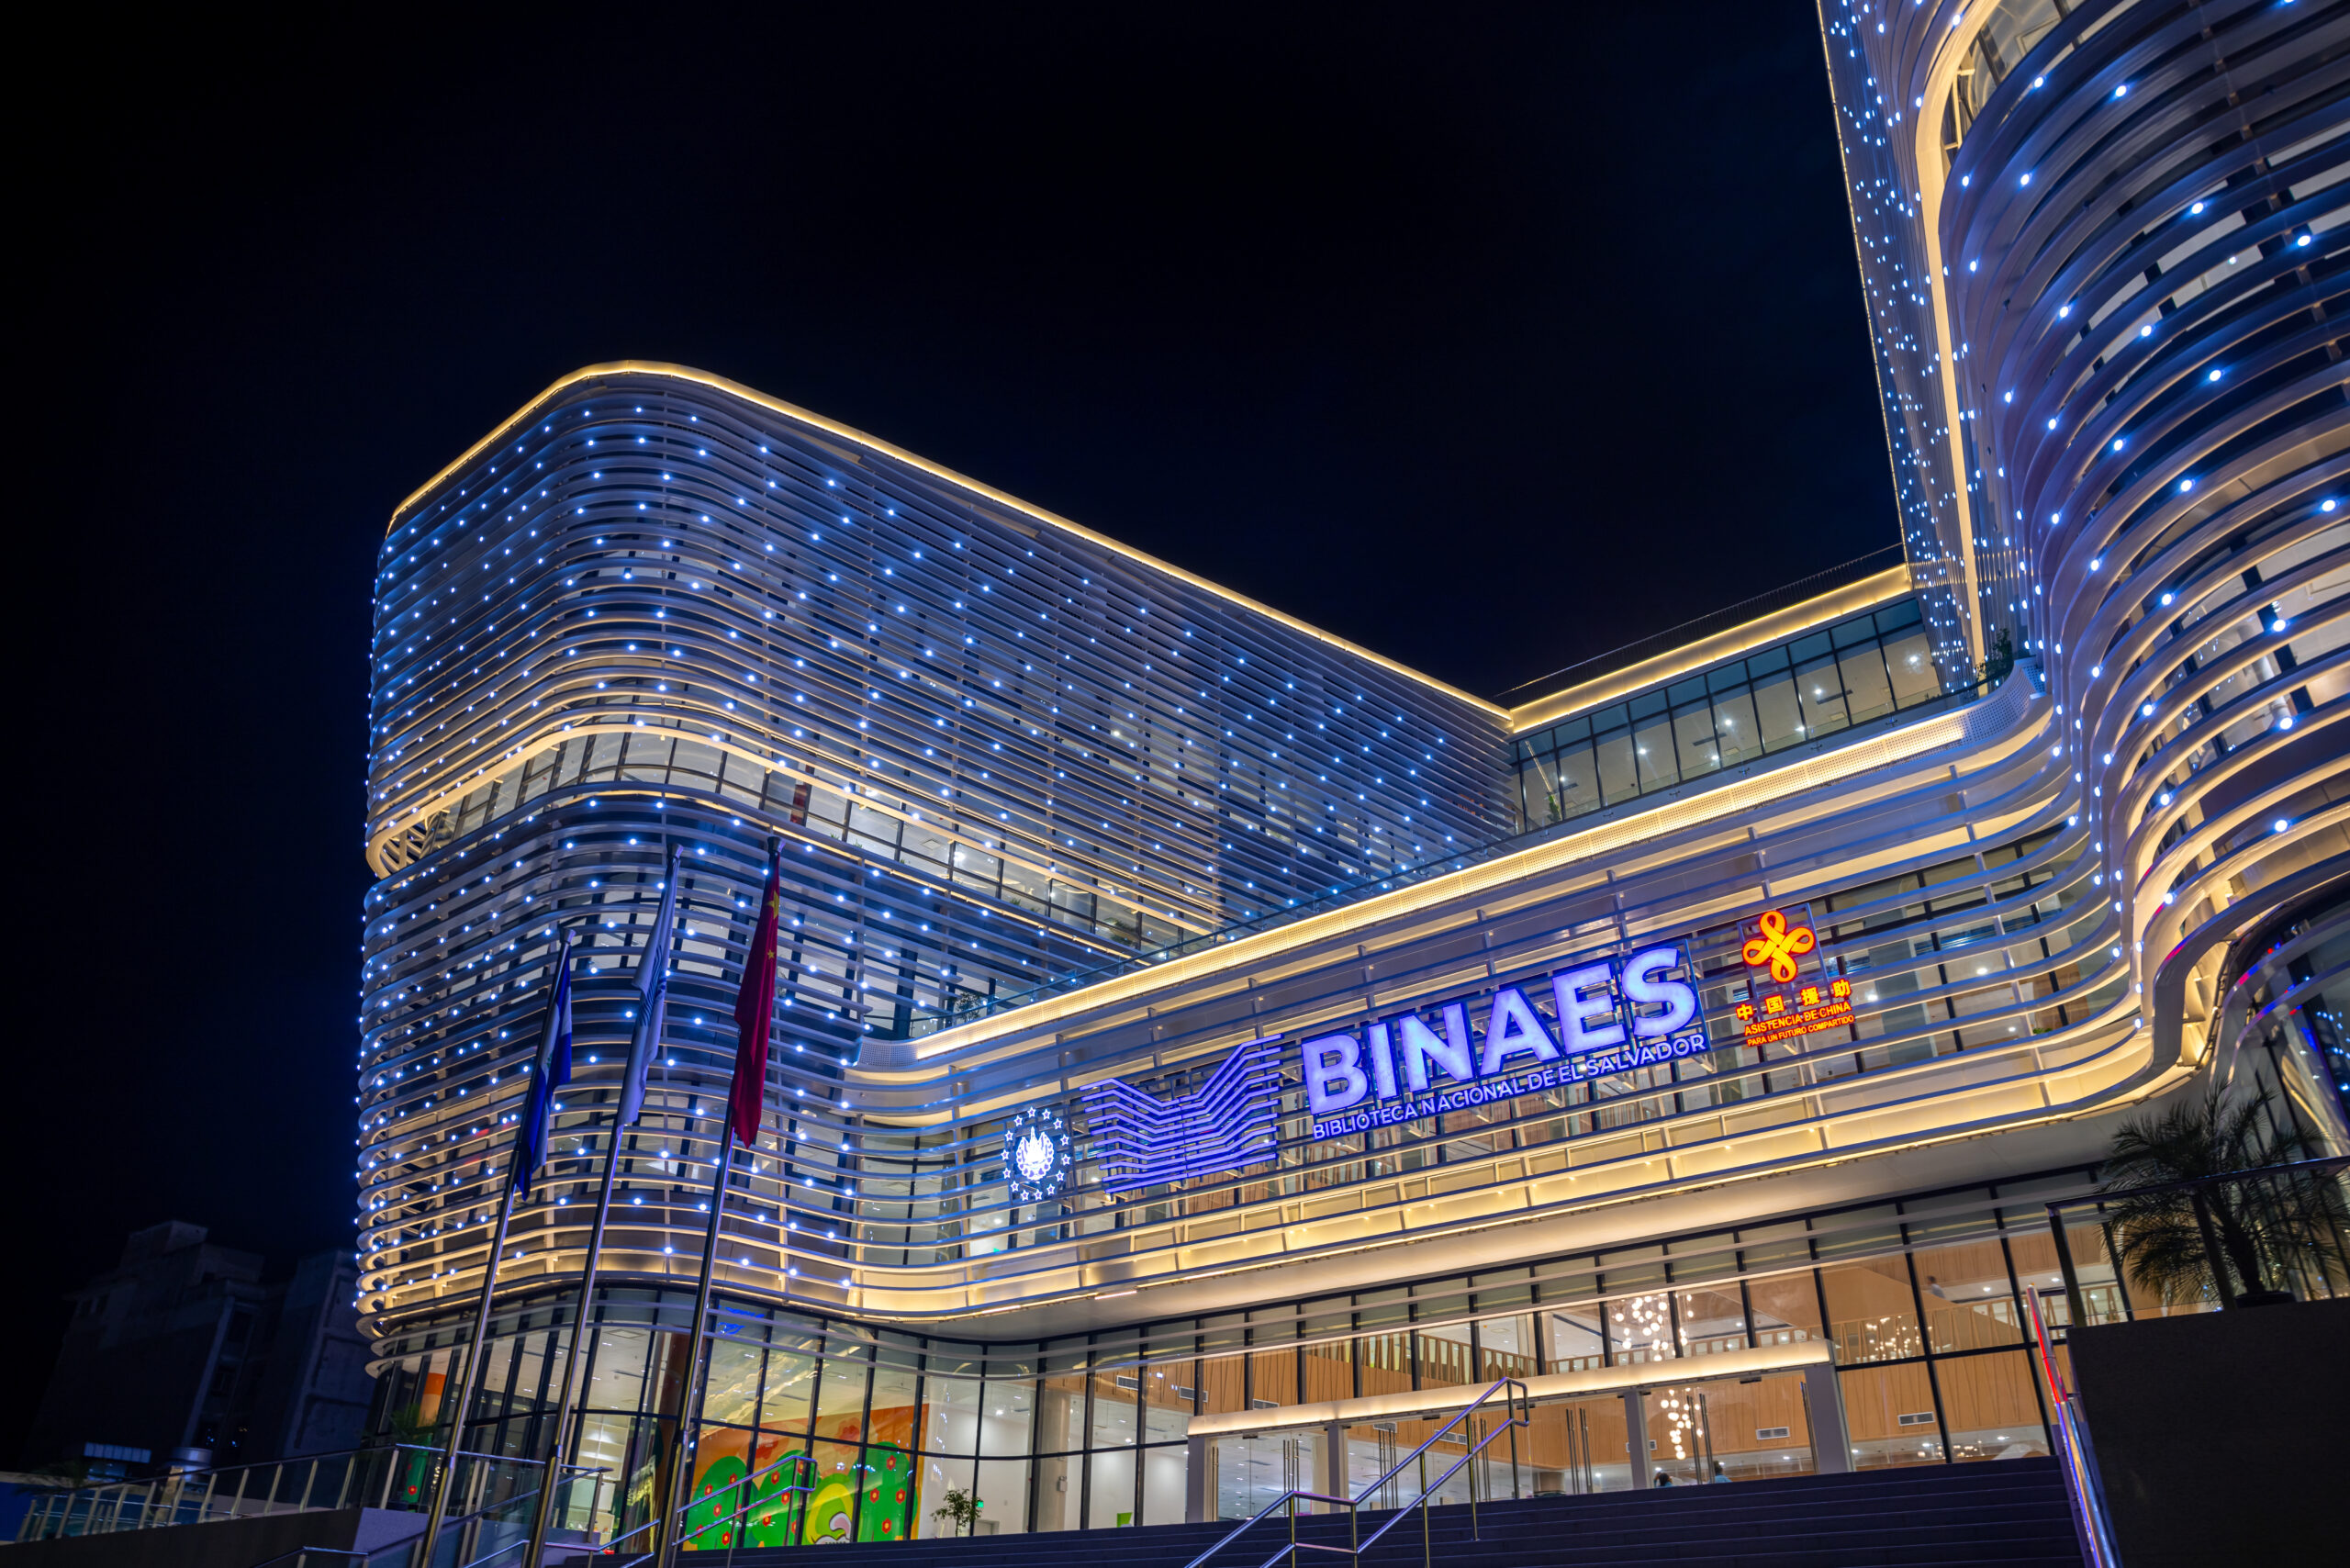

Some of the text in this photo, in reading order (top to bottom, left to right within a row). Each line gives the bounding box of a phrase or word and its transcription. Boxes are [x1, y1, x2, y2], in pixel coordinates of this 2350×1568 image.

[1736, 979, 1852, 1021] 中国援助
[1744, 1001, 1852, 1036] ASISTENCIA DE CHINA
[1302, 947, 1697, 1115] BINAES
[1747, 1014, 1854, 1047] PARA UN FUTURO COMPARTIDO
[1313, 1033, 1706, 1141] BIBLIOTECA NACIONAL DE EL SALVADOR
